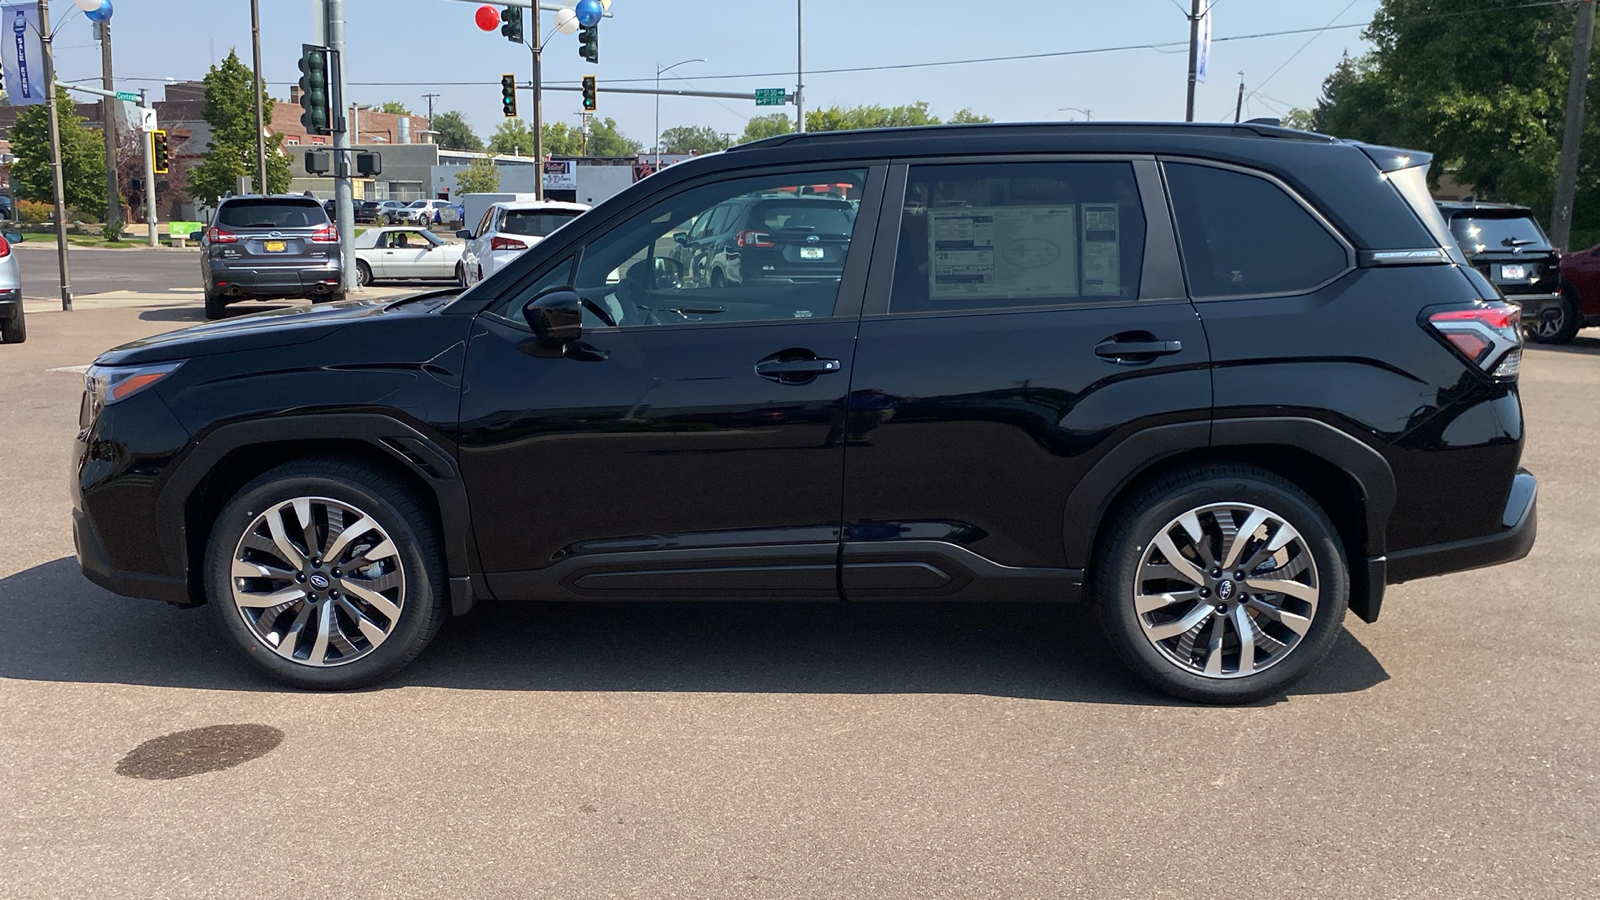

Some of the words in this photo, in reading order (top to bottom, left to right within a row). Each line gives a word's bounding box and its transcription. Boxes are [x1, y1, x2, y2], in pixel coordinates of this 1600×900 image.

[17, 38, 25, 61] SALE
[20, 67, 28, 95] EVENT
[117, 92, 135, 101] Central
